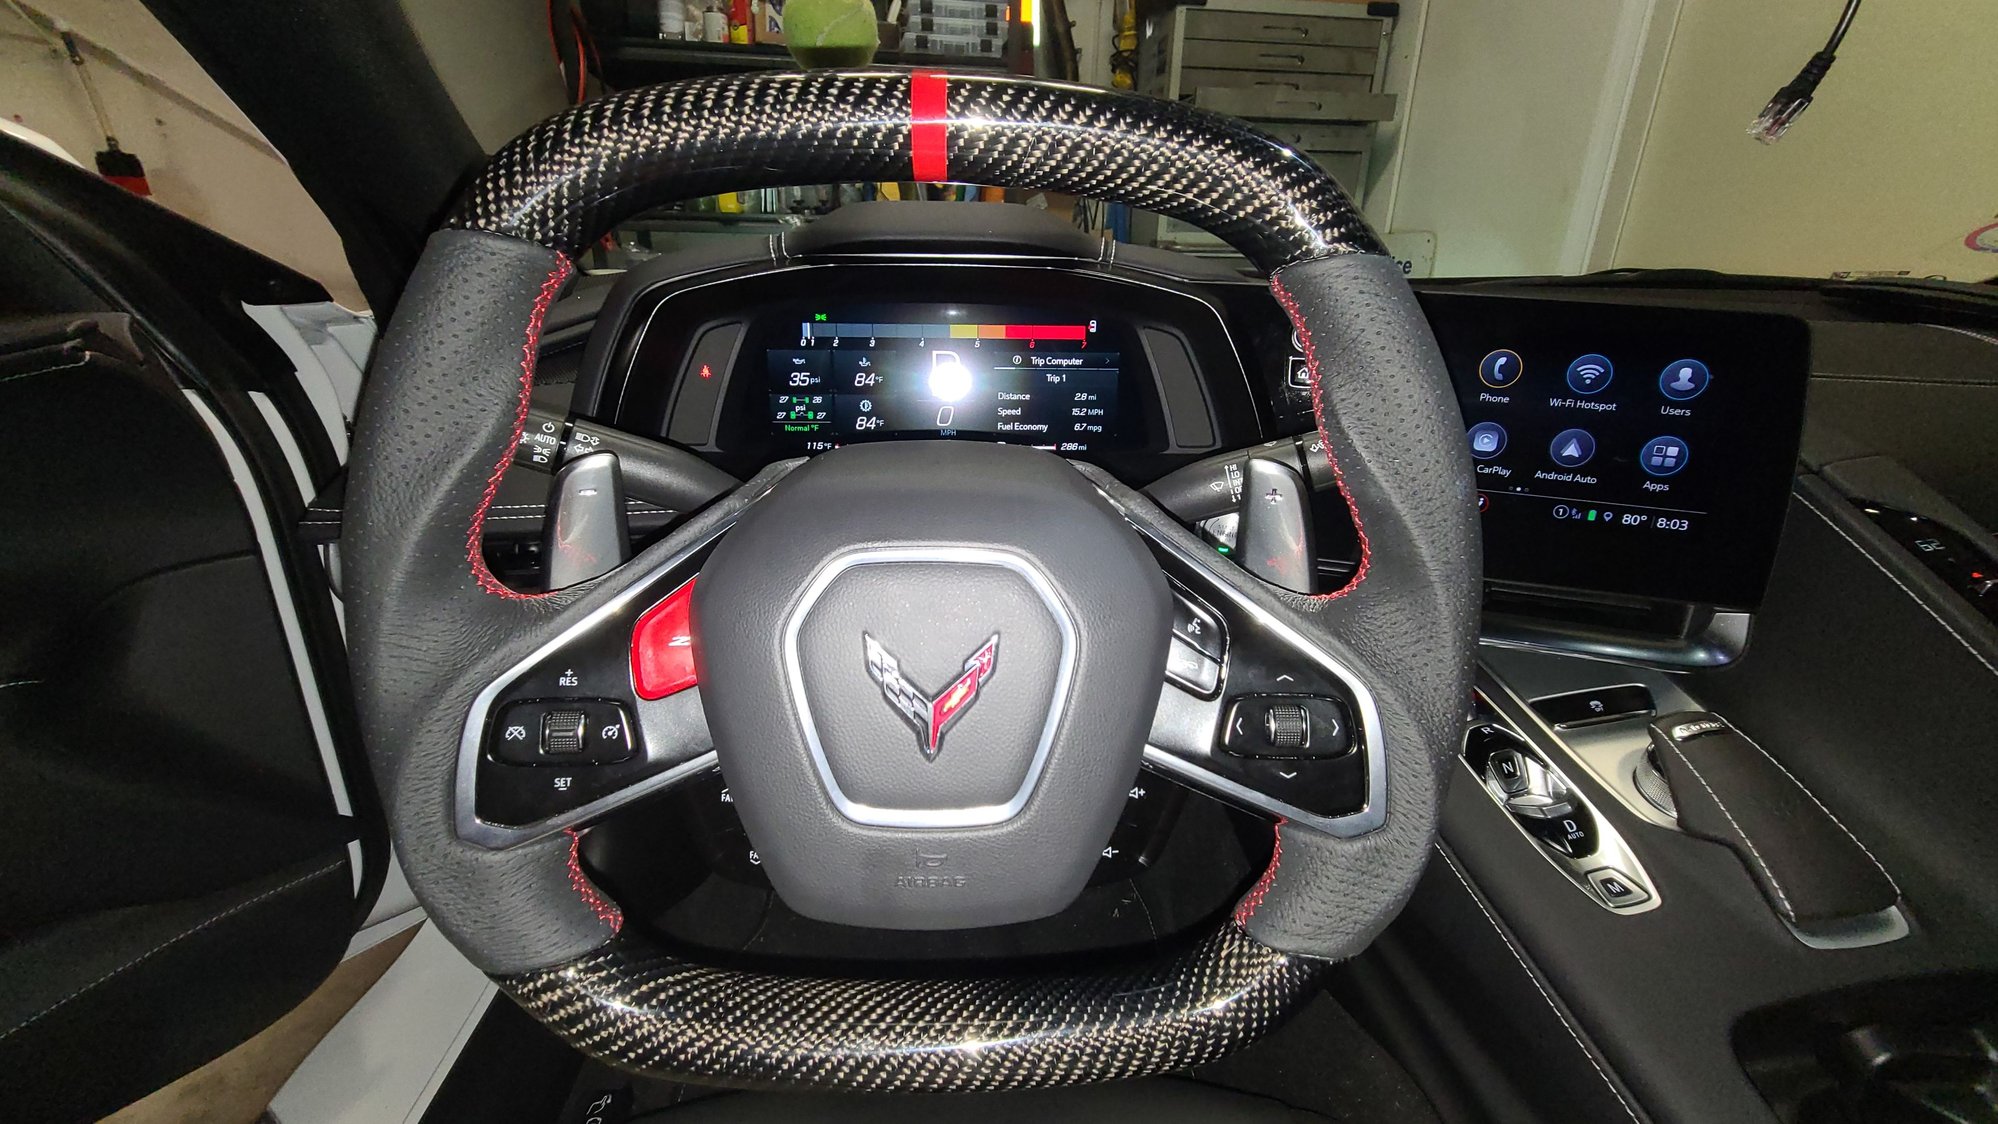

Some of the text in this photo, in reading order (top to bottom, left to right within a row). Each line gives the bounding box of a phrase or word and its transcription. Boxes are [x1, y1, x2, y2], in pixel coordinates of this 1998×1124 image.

[1030, 356, 1084, 367] Trip Computer
[789, 372, 811, 386] 35
[1046, 373, 1061, 384] Trip
[779, 396, 789, 404] 27
[997, 392, 1031, 401] Distance
[1088, 393, 1097, 401] mi
[1480, 392, 1510, 403] Phone
[1549, 398, 1617, 412] Wi-Fi Hotspot
[776, 411, 827, 420] 27 27
[997, 407, 1022, 417] Speed
[1087, 408, 1104, 416] MPH
[1660, 405, 1691, 416] Users
[784, 424, 810, 432] Normal
[997, 422, 1048, 432] Fuel Economy
[1087, 424, 1102, 432] mpg
[534, 432, 557, 445] AUTO
[1229, 464, 1238, 472] HI
[1476, 465, 1512, 478] CarPlay
[1230, 471, 1240, 479] LO
[1534, 470, 1597, 484] Android Auto
[1642, 480, 1670, 492] Apps
[1656, 517, 1689, 531] 8:03
[559, 676, 578, 686] RES
[1481, 726, 1495, 736] R
[1502, 761, 1514, 775] N
[553, 777, 572, 787] SET
[1563, 819, 1578, 833] D
[1567, 831, 1585, 841] AUTO
[1606, 881, 1625, 895] M
